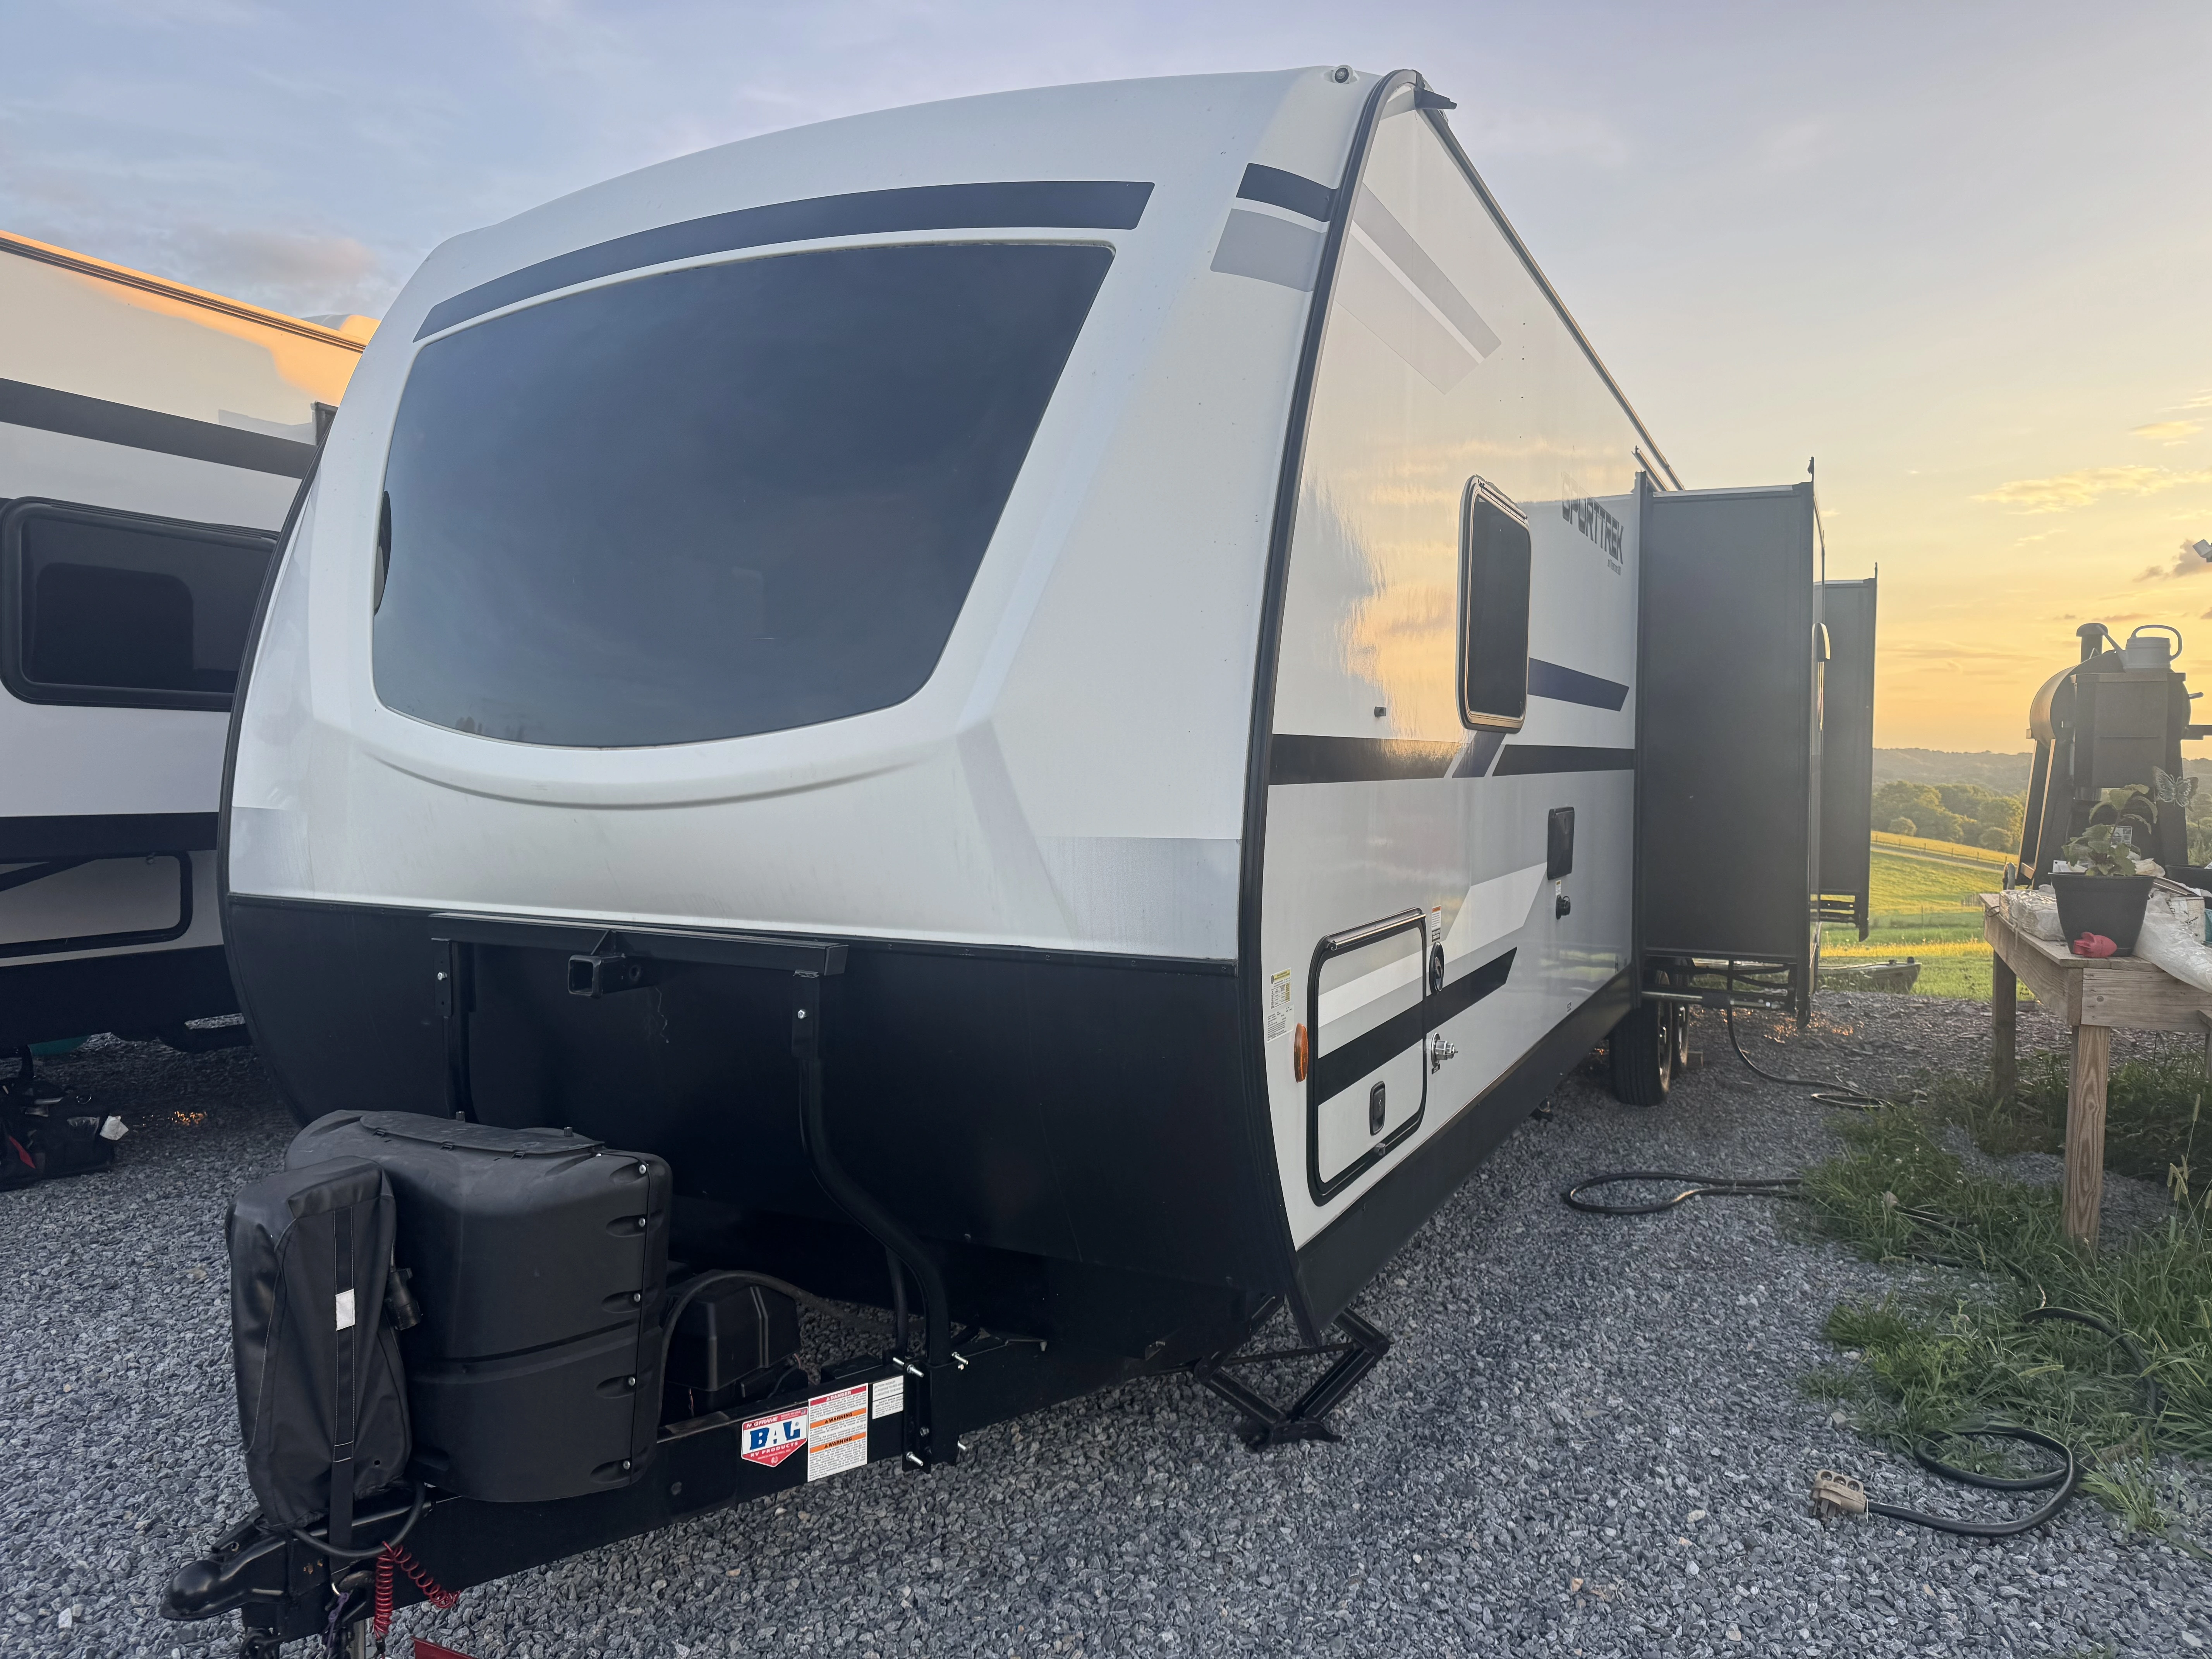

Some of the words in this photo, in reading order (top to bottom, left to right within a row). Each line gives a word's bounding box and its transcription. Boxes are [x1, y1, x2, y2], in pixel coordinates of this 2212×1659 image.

[830, 1391, 852, 1400] DANGER
[829, 1412, 852, 1423] WARNING
[749, 1421, 800, 1451] BAL
[828, 1437, 852, 1447] WARNING
[762, 1442, 799, 1455] PRODUCTS
